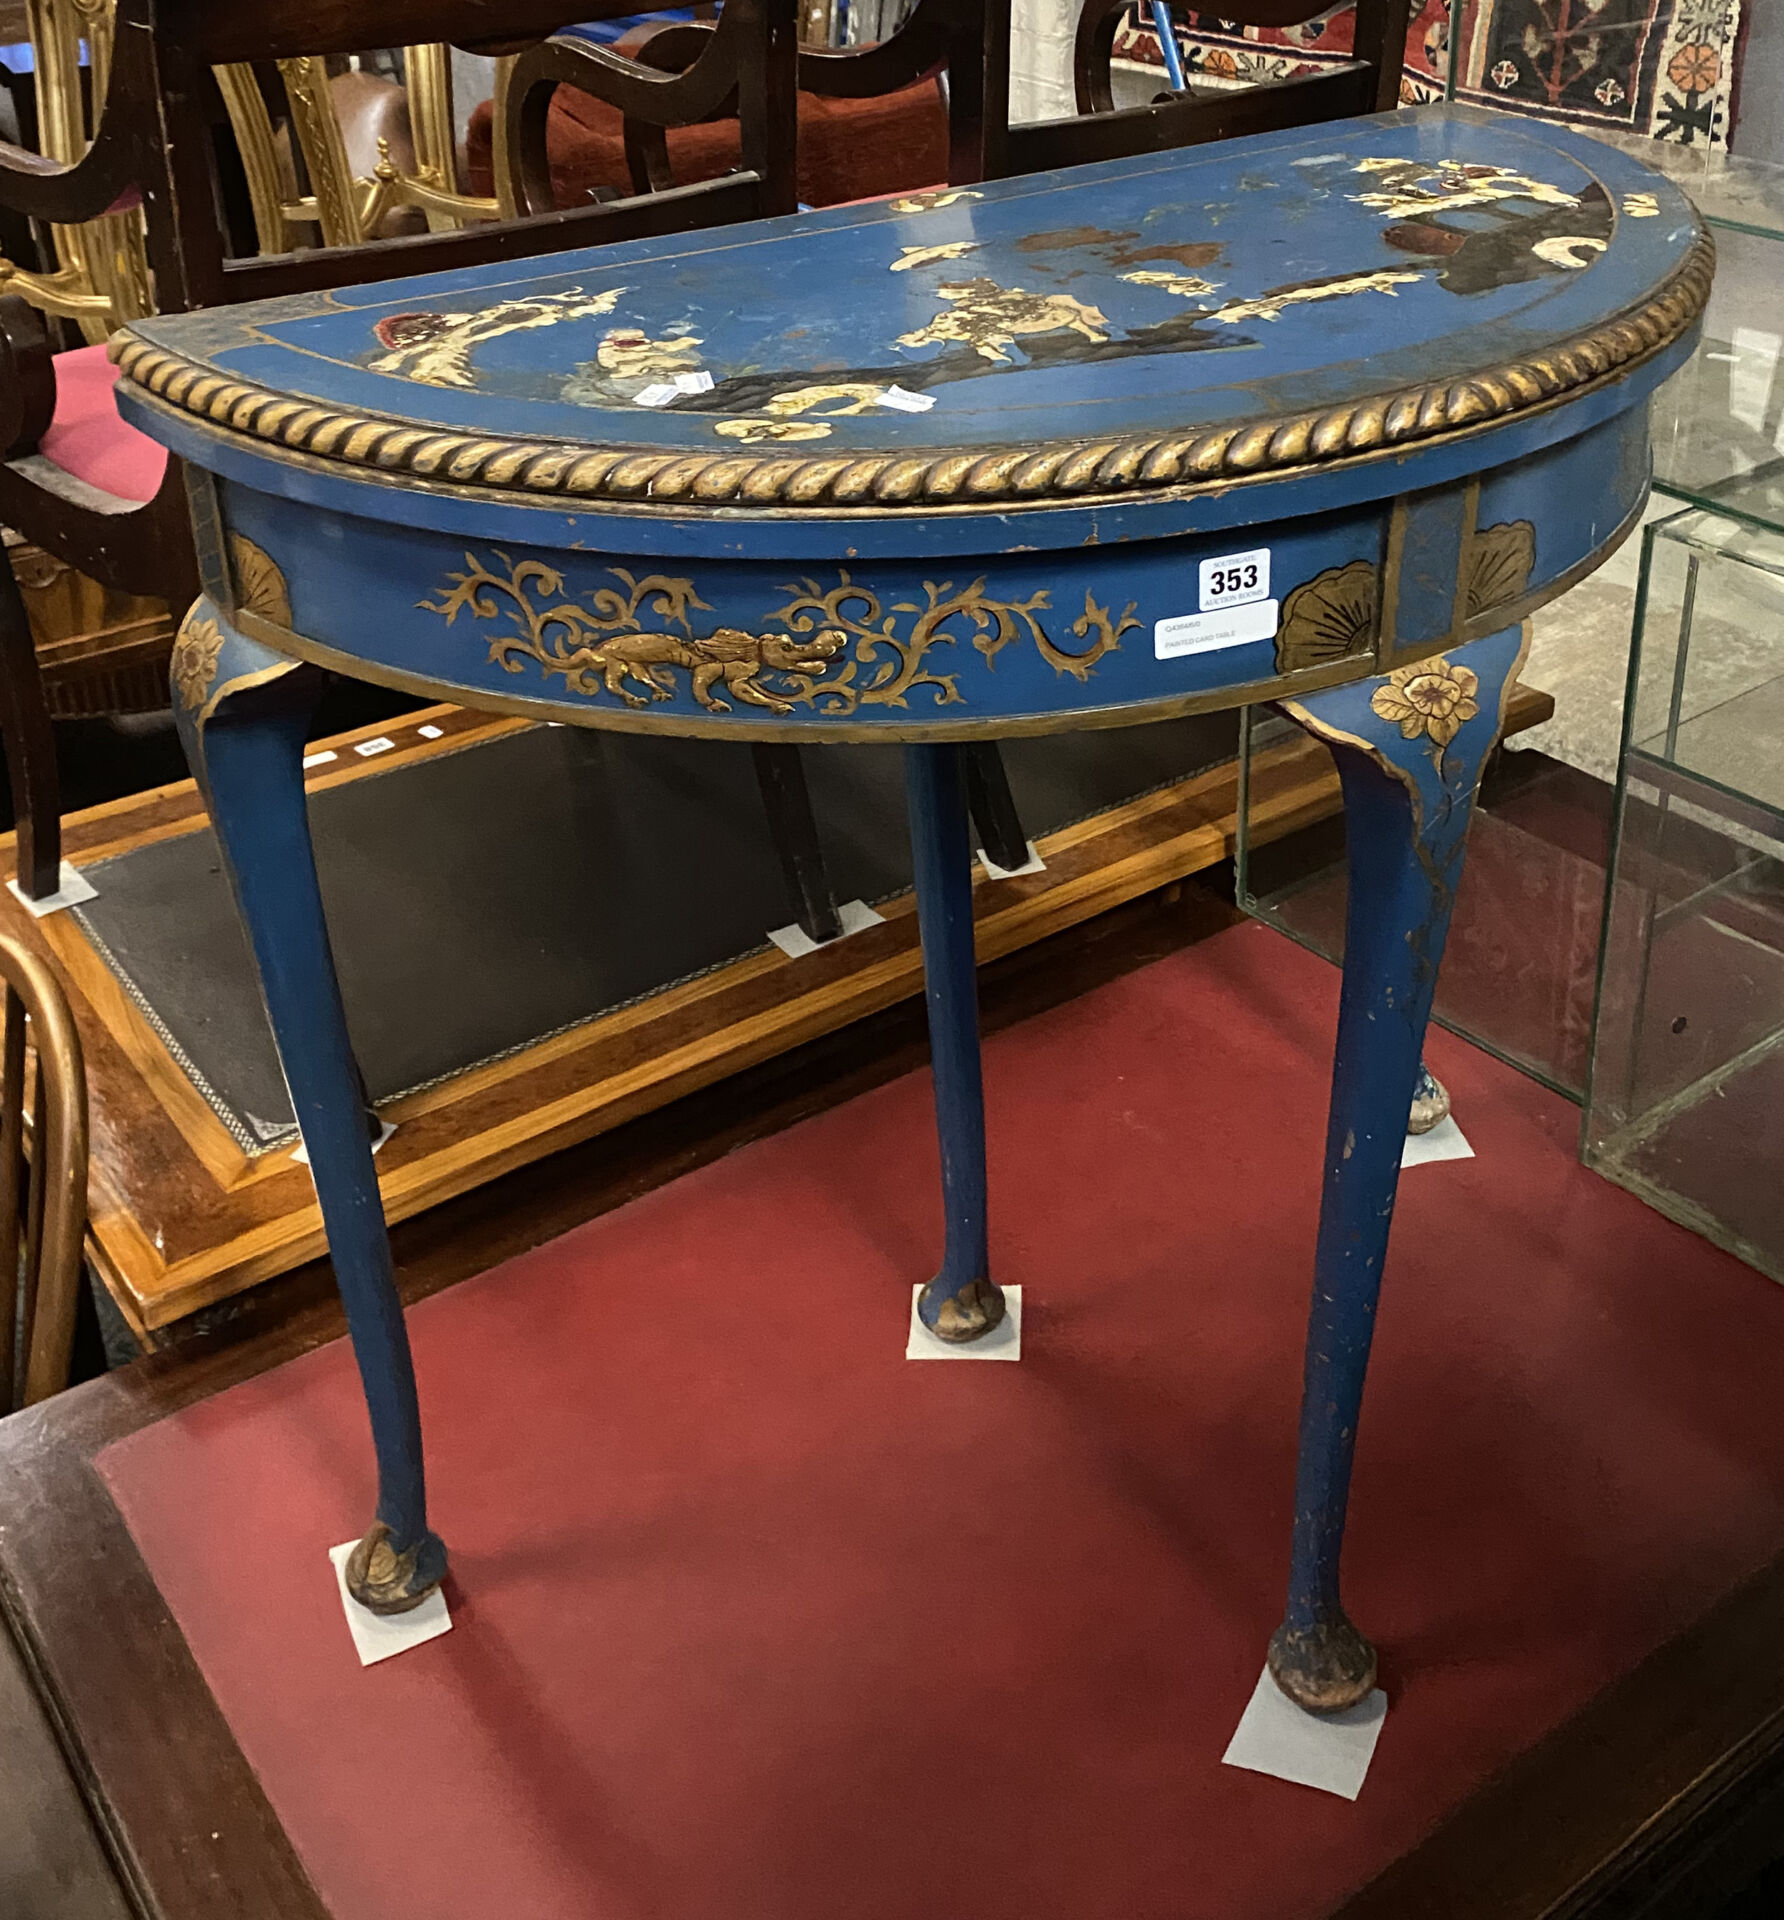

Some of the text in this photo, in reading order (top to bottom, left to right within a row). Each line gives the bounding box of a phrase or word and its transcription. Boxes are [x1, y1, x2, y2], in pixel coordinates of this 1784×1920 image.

[1213, 555, 1257, 568] SOUTHGATE
[1210, 564, 1258, 595] 353
[1204, 589, 1264, 606] AUCTION ROOMS
[1165, 630, 1236, 648] PAINTED CARD TABLE
